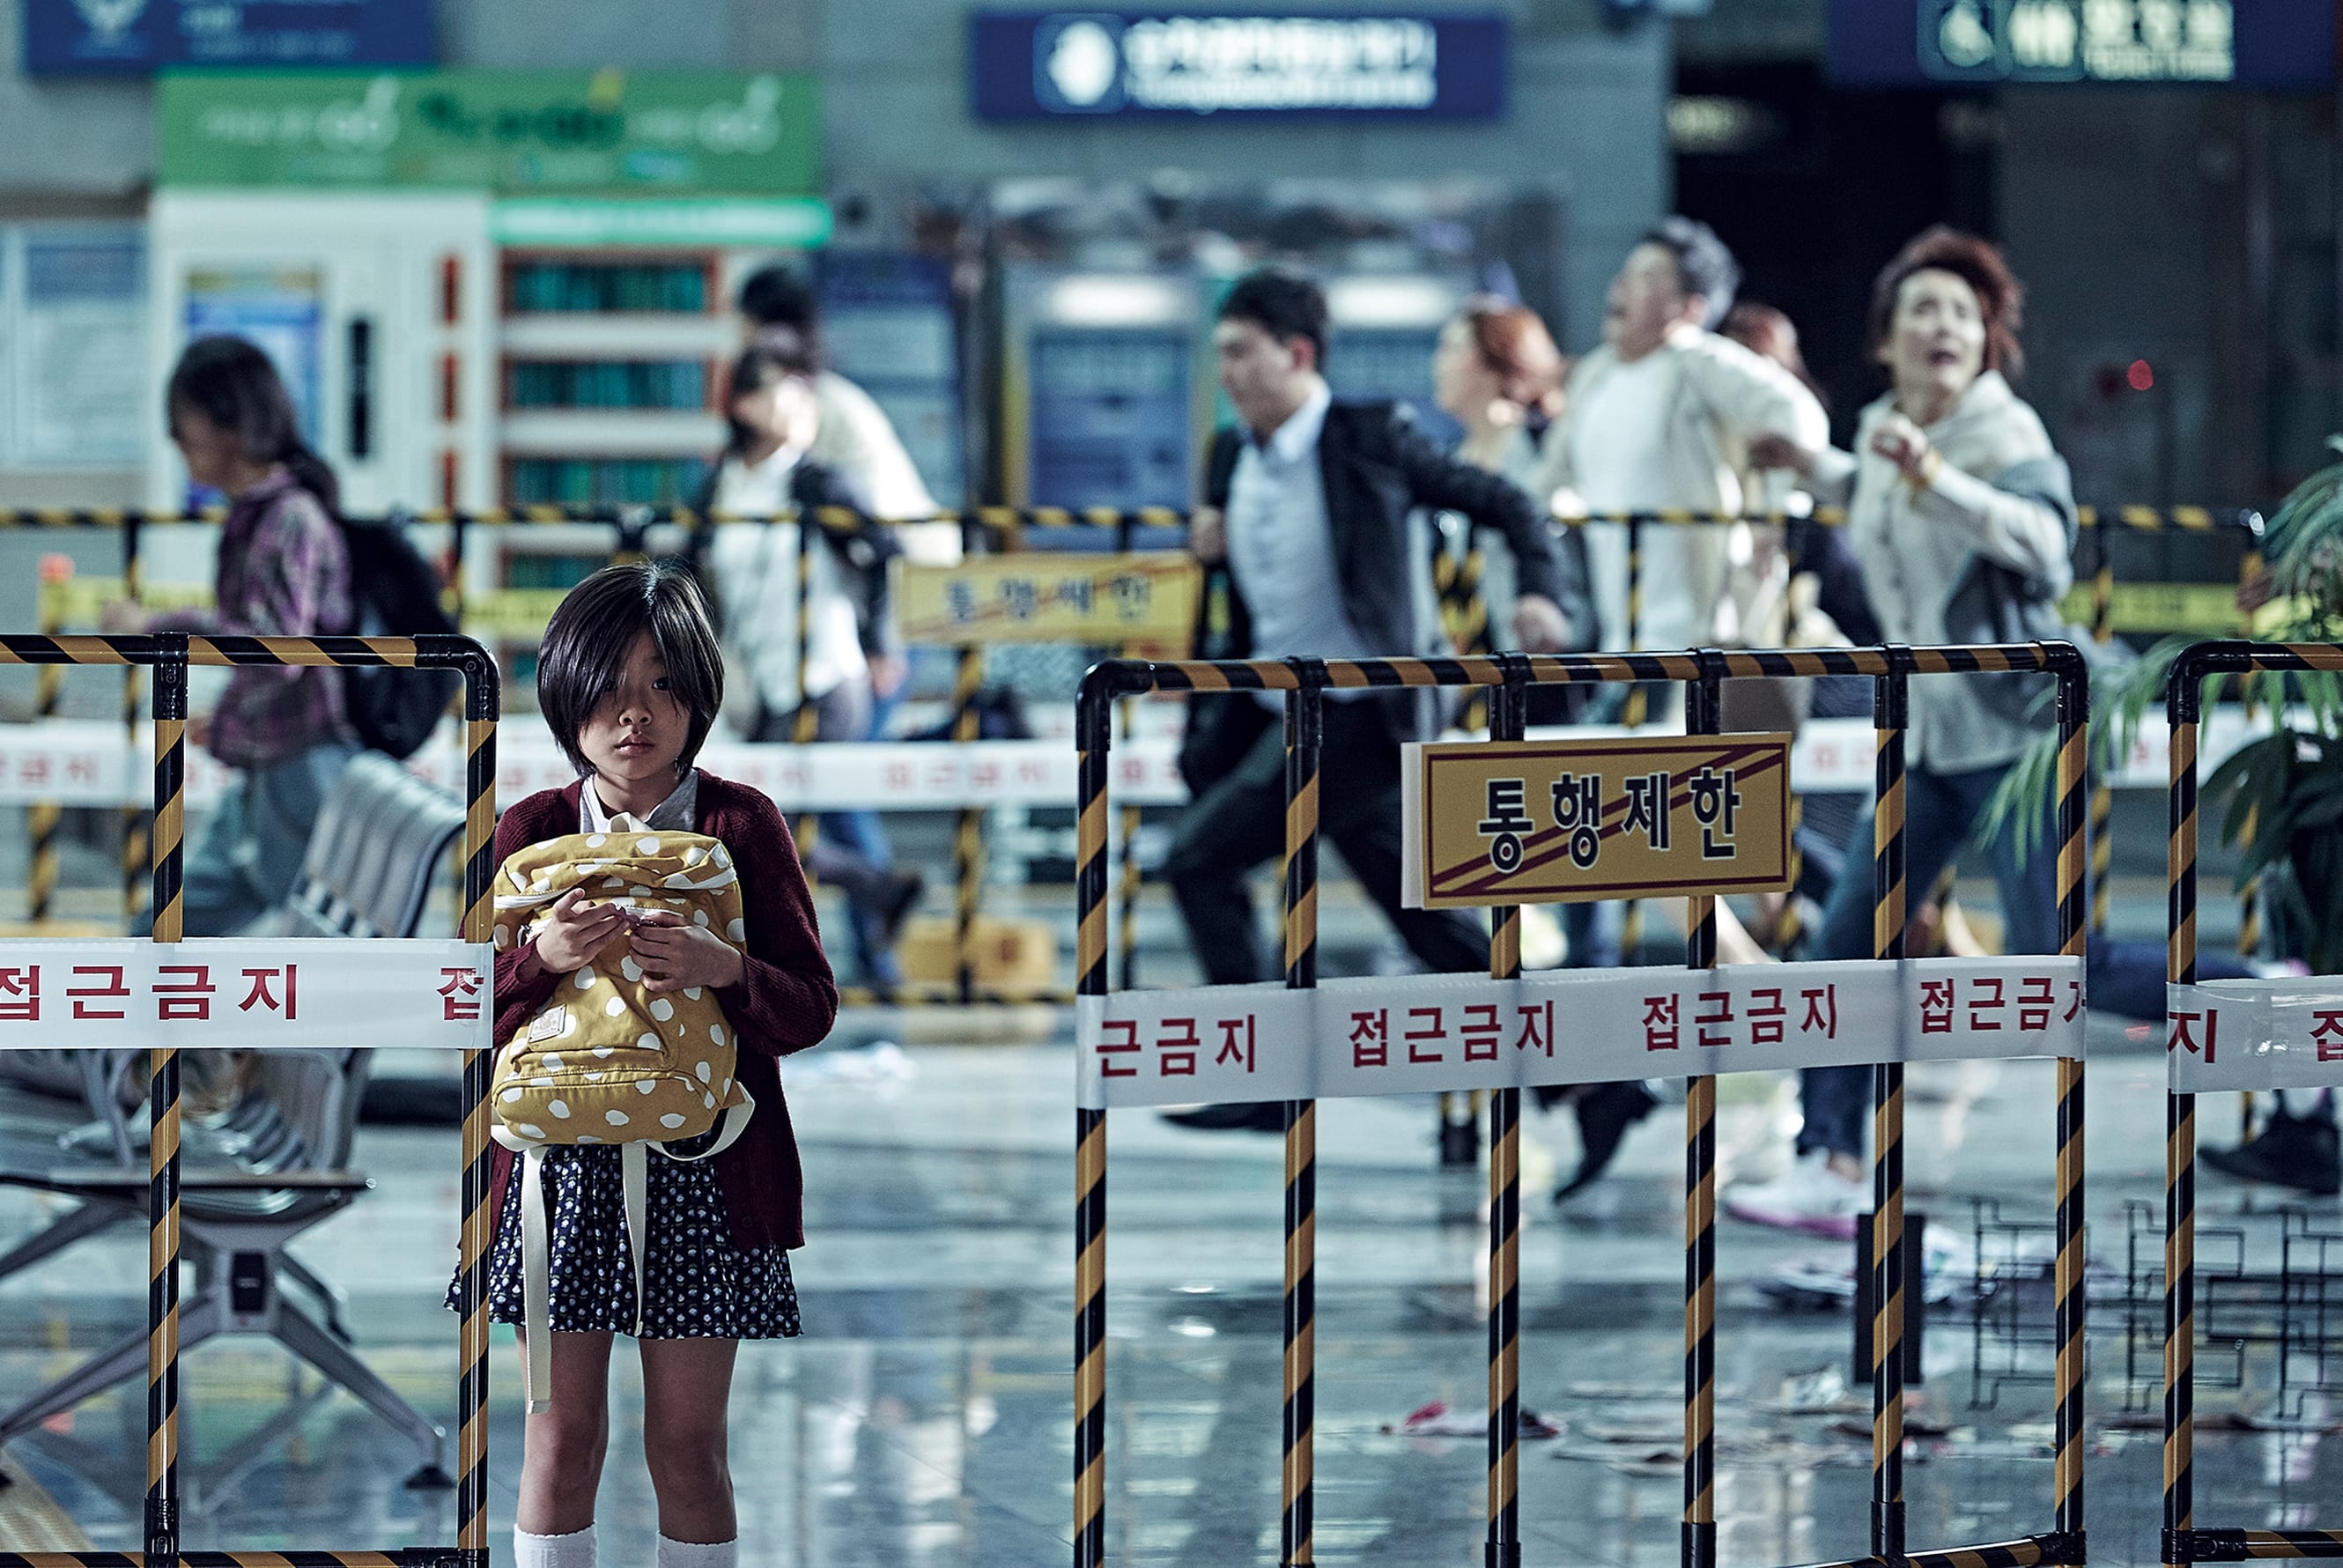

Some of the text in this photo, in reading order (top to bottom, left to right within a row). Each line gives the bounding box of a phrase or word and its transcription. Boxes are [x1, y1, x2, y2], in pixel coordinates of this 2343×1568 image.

[1477, 766, 1741, 874] 통행제한
[0, 965, 297, 1020] 접근금지
[1095, 1014, 1256, 1078] 근금지
[1349, 1000, 1555, 1068] 접근금지
[1643, 984, 1837, 1051] 접근금지
[2167, 1009, 2218, 1063] 지
